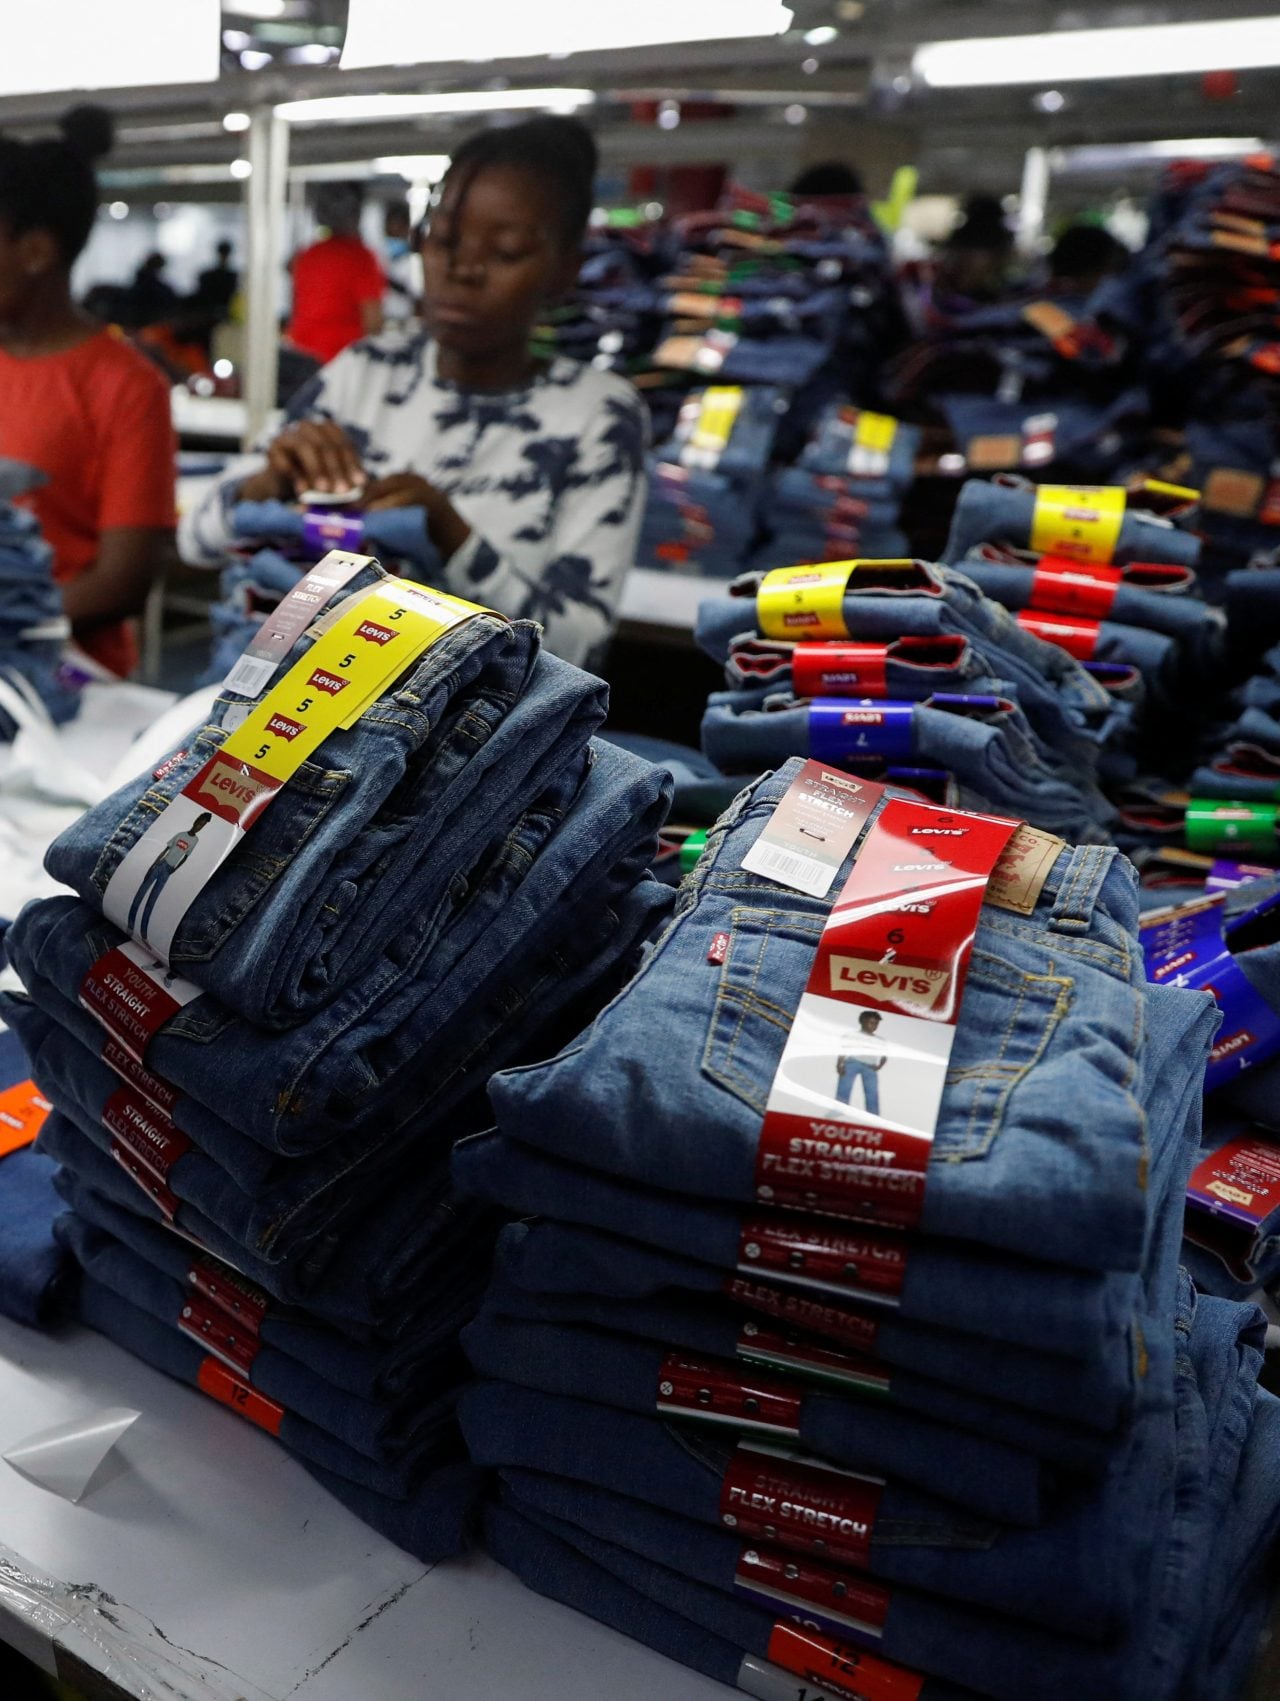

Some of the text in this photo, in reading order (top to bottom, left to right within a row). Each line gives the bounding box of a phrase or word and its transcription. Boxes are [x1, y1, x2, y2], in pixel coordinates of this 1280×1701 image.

[389, 609, 407, 620] 5
[339, 654, 356, 668] 5
[296, 699, 313, 712] 5
[254, 745, 270, 759] 5
[798, 793, 854, 818] STRETCH
[886, 928, 905, 944] 6
[103, 973, 150, 1017] STRAIGHT
[123, 967, 157, 1000] YOUTH
[85, 978, 149, 1042] FLEX STRETCH
[122, 1104, 170, 1149] STRAIGHT
[810, 1122, 883, 1145] YOUTH
[789, 1138, 897, 1166] STRAIGHT
[762, 1154, 918, 1193] FLEX STRETCH
[231, 1384, 250, 1406] 12
[729, 1486, 868, 1539] FLEX STRETCH
[831, 1647, 861, 1676] 12
